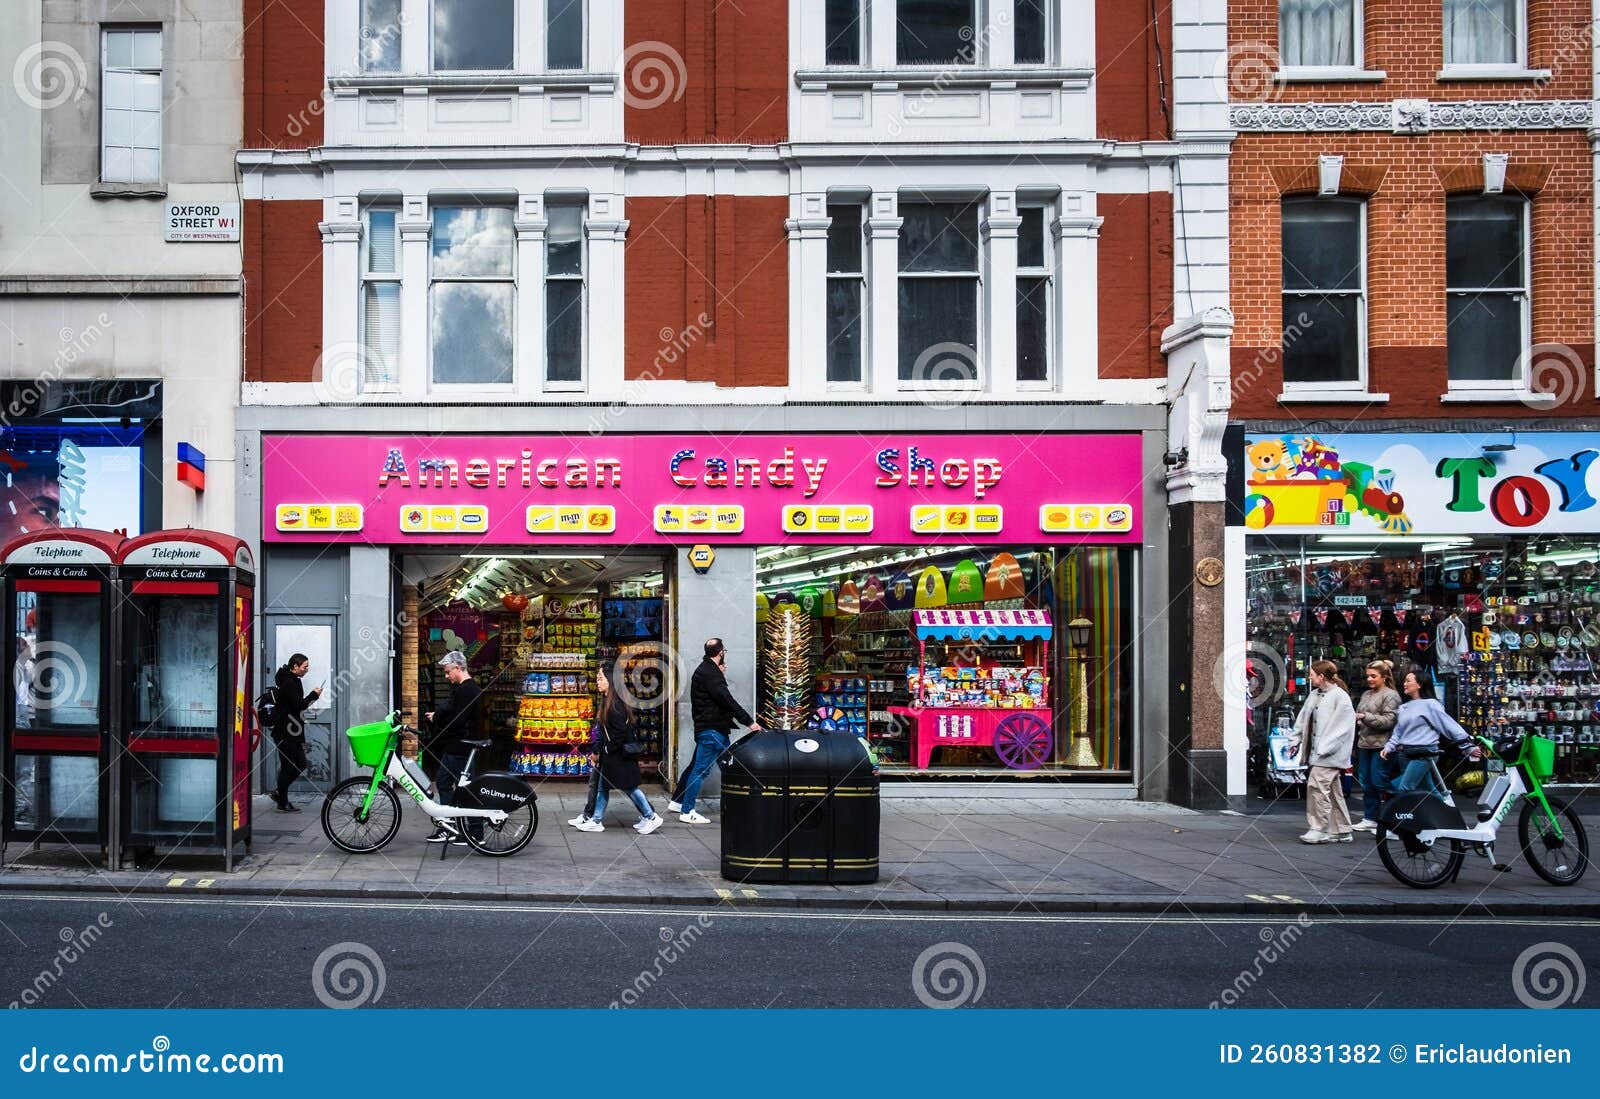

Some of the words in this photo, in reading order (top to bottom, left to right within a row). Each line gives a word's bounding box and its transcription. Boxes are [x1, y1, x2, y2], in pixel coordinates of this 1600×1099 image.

[171, 206, 220, 216] OXFORD
[171, 218, 214, 228] STREET
[218, 218, 234, 228] W1
[379, 448, 621, 488] American
[670, 446, 827, 497] Candy
[876, 446, 1002, 499] Shop
[1435, 450, 1600, 528] TOY
[35, 546, 84, 558] Telephone
[151, 547, 201, 559] Telephone
[28, 567, 51, 576] Coins
[53, 567, 61, 576] &
[62, 568, 88, 577] Cards
[146, 568, 169, 578] Coins
[170, 569, 179, 578] &
[181, 569, 206, 578] Cards
[1475, 635, 1487, 649] £1
[400, 774, 424, 803] Lime
[480, 787, 490, 795] On
[491, 790, 506, 799] Lime
[511, 794, 526, 802] Uber
[1395, 811, 1414, 820] Lime
